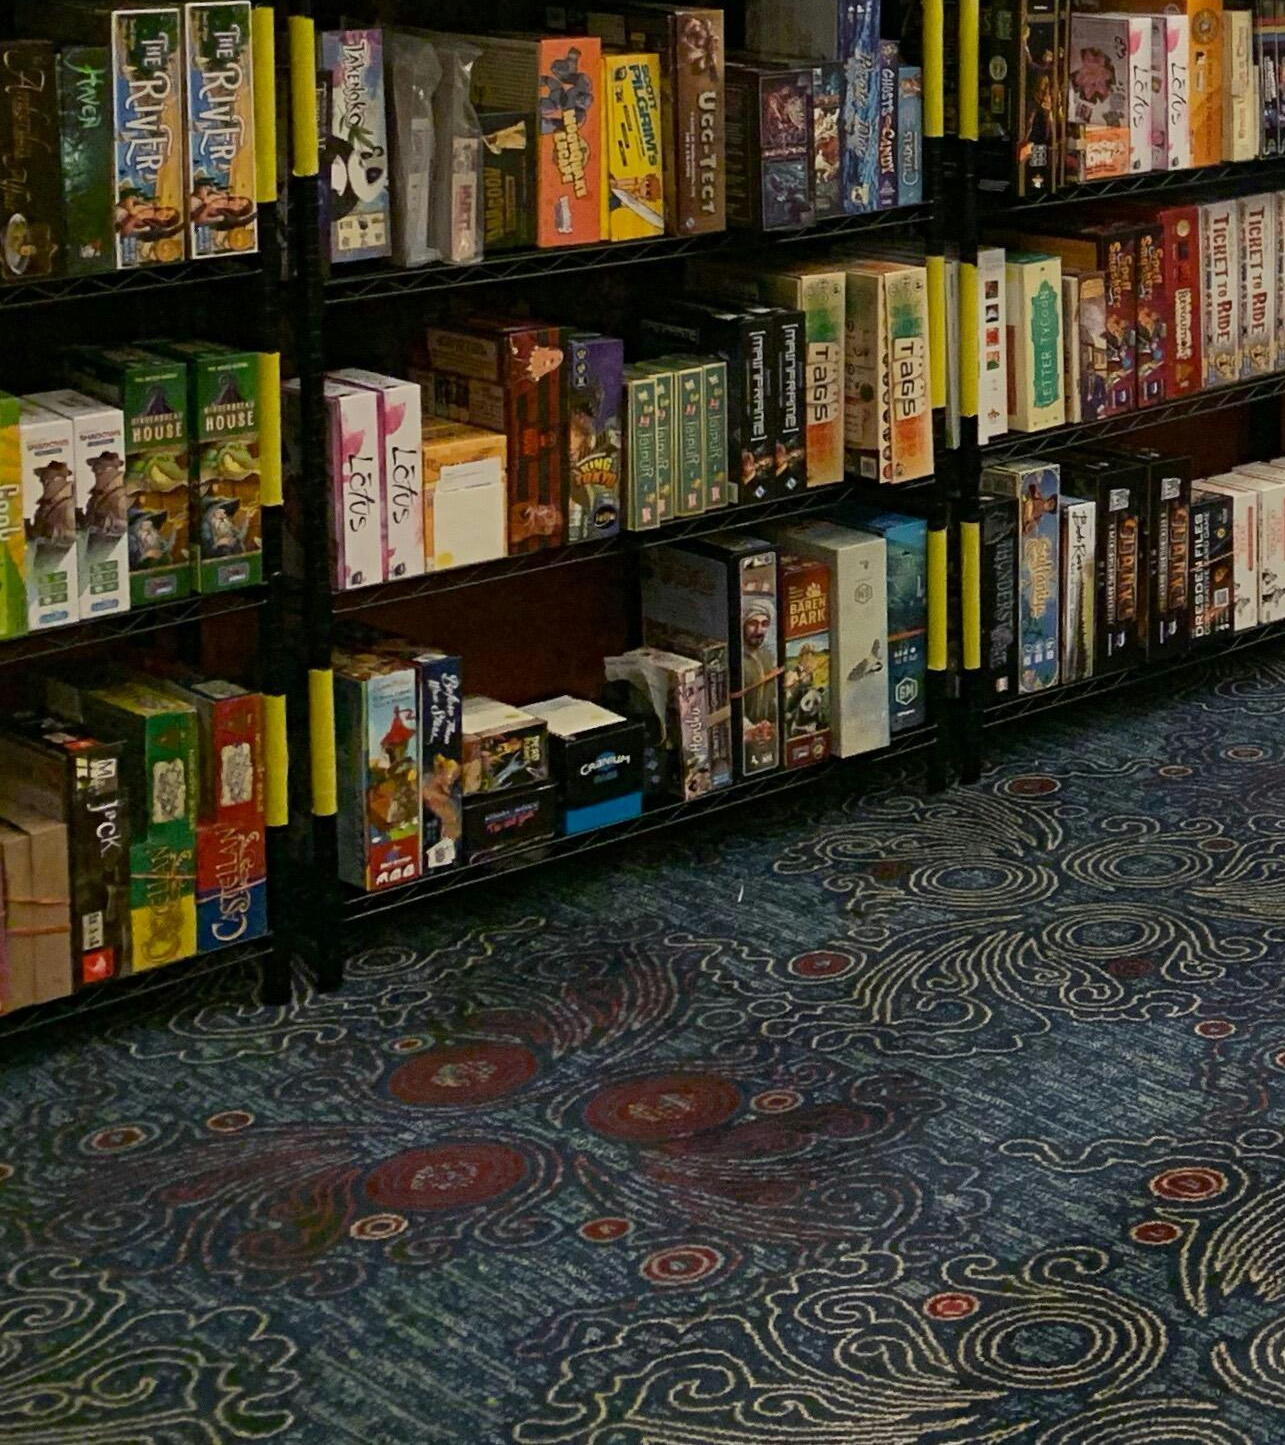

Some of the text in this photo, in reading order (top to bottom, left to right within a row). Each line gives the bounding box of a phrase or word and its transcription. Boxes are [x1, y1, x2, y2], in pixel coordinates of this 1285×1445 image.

[142, 32, 169, 67] THE
[214, 24, 241, 59] THE
[199, 63, 246, 172] RIVER
[342, 40, 368, 128] TAKENOKO
[641, 65, 657, 110] SCOTT
[125, 71, 172, 181] RIVER
[700, 92, 716, 213] UGG-TECT
[1213, 212, 1232, 343] TICKET TO RIDE
[1249, 206, 1267, 335] TICKET TO RIDE
[1041, 289, 1053, 407] LETTER TYCOON
[132, 421, 183, 443] HOUSE
[205, 411, 254, 432] HOUSE
[580, 456, 613, 472] KING
[1194, 513, 1205, 637] DRESDEN FILES
[790, 610, 826, 629] PARK
[689, 707, 703, 754] Honshu
